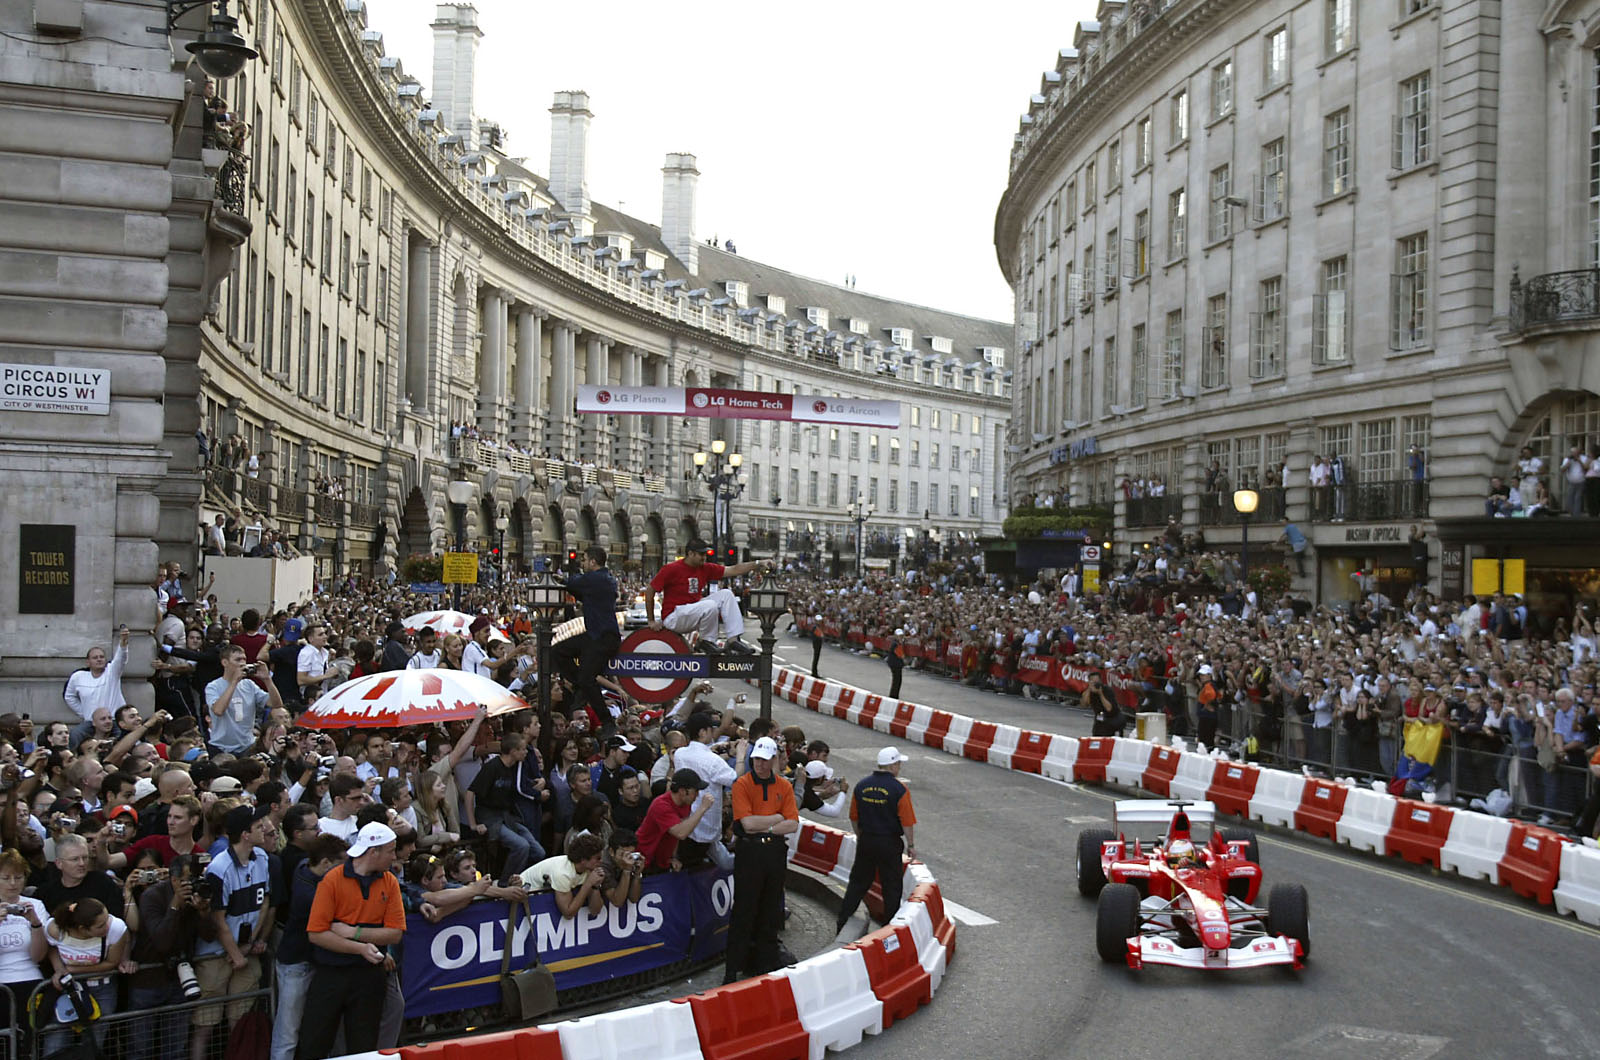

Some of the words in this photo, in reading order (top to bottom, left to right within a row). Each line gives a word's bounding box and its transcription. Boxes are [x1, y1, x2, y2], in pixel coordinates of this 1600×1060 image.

[5, 369, 101, 385] PICCADILLY
[4, 384, 68, 398] CIRCUS
[75, 388, 95, 399] W1
[614, 394, 628, 402] LG
[633, 395, 666, 403] Plasma
[711, 397, 725, 406] LG
[729, 398, 758, 408] Home
[761, 399, 783, 409] Tech
[830, 404, 844, 413] LG
[849, 407, 880, 416] Aircon
[30, 552, 64, 566] TOWER
[25, 571, 69, 584] RECORDS
[717, 662, 754, 671] SUBWAY
[430, 892, 664, 970] OLYMPUS
